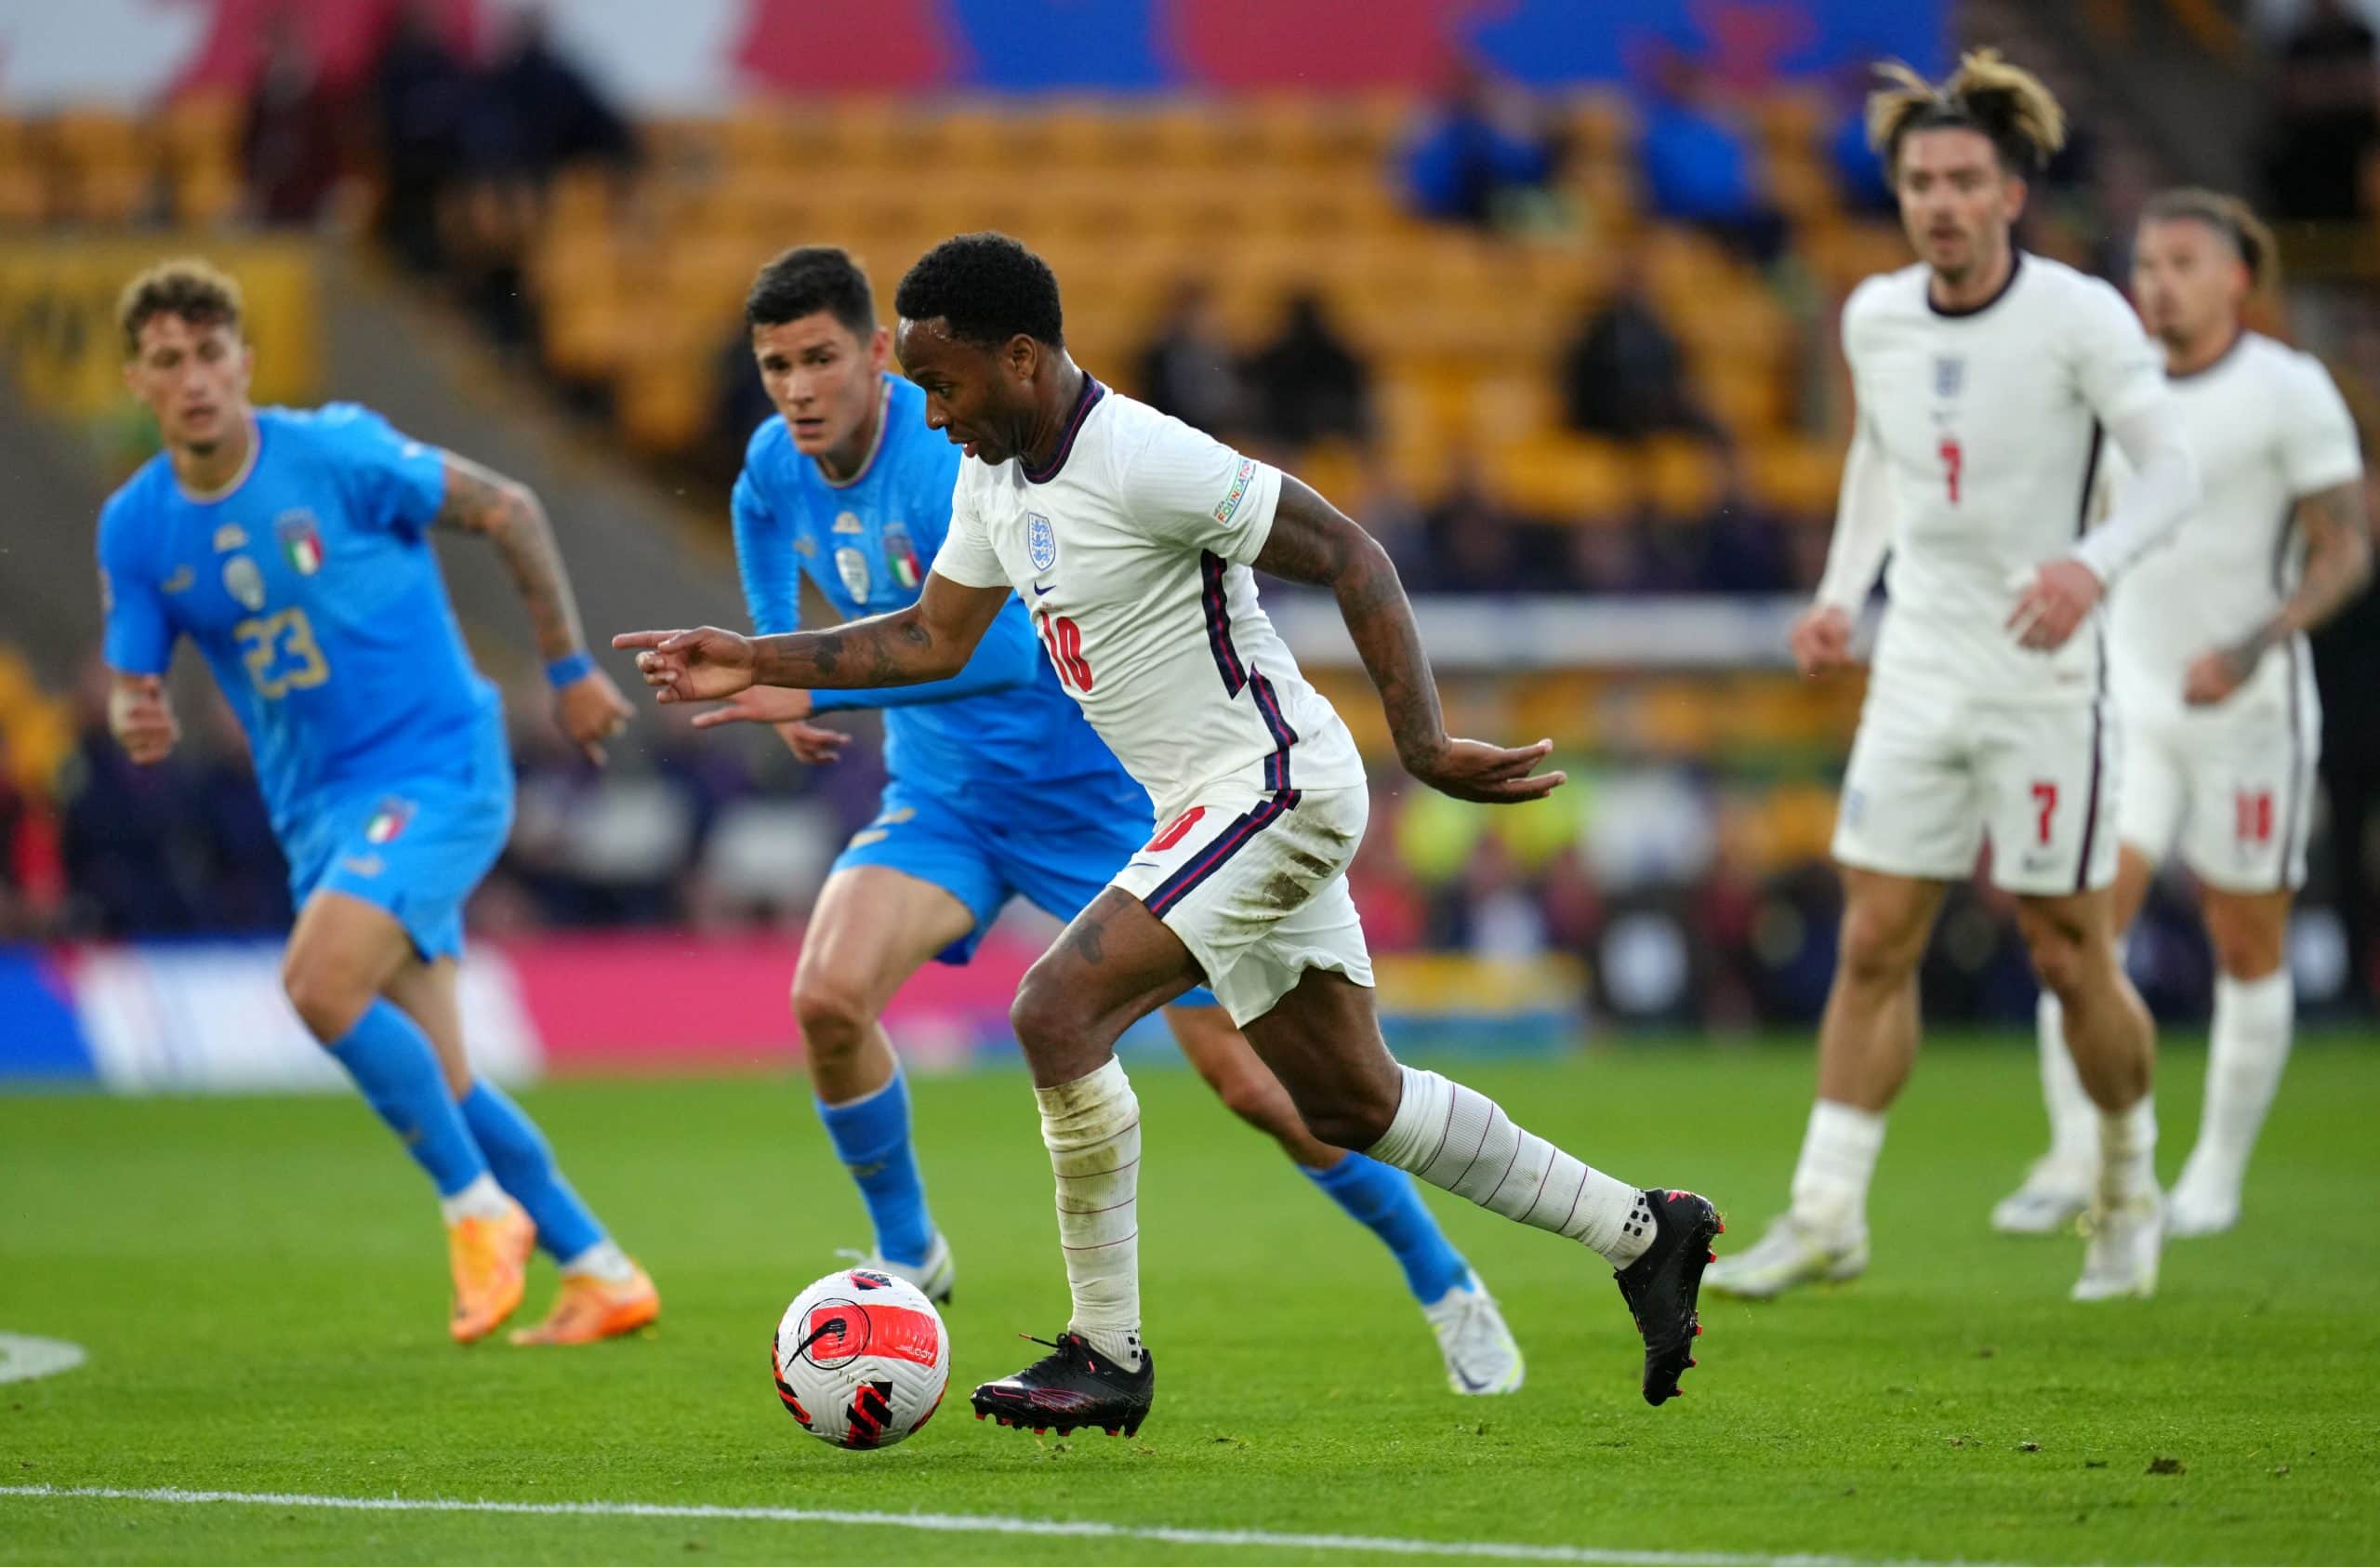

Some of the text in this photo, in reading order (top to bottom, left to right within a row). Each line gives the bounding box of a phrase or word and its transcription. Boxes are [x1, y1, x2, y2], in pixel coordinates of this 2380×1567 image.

[1938, 437, 1963, 504] 7
[231, 605, 330, 699] 23
[1038, 610, 1093, 692] 10
[1144, 805, 1206, 852] 0
[2030, 781, 2059, 845] 7
